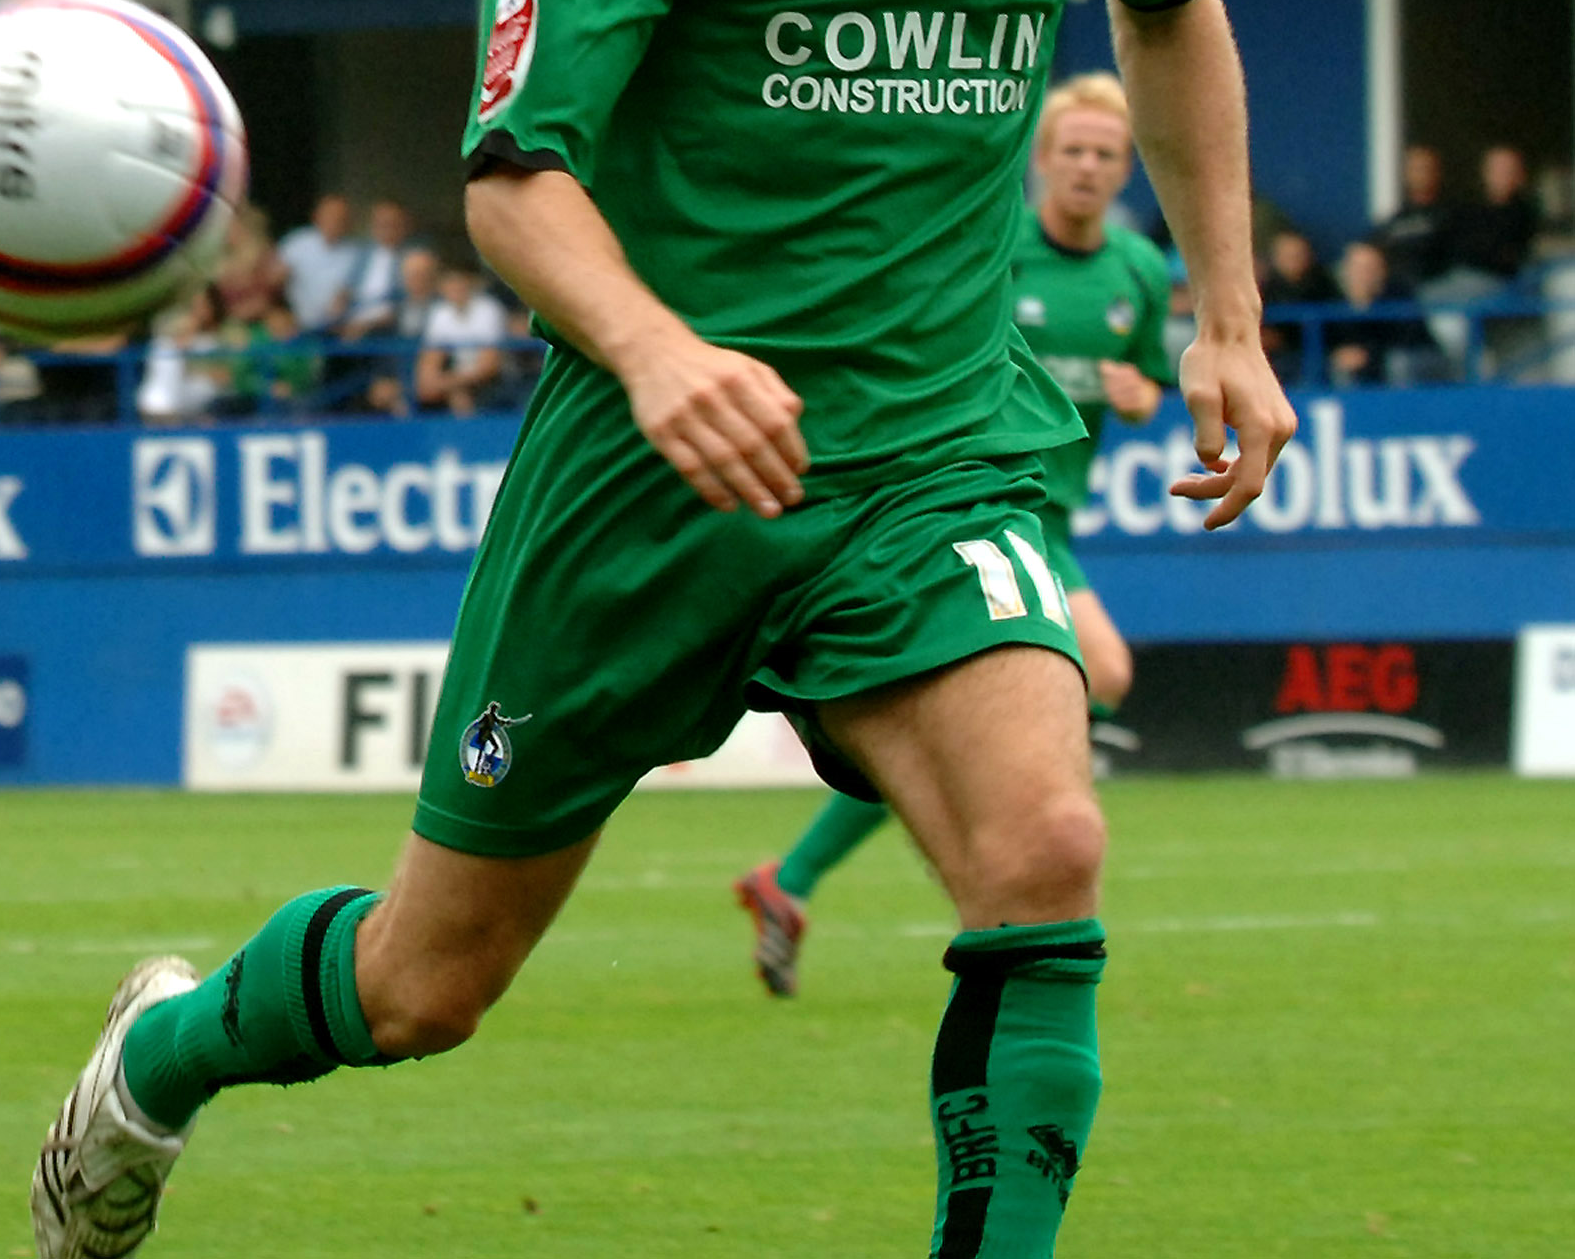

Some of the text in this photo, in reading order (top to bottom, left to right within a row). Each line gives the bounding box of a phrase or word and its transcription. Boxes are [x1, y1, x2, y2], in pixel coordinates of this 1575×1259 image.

[764, 10, 1046, 72] COWLIN
[762, 72, 1031, 115] CONSTRUCTION
[1274, 644, 1419, 713] AEG
